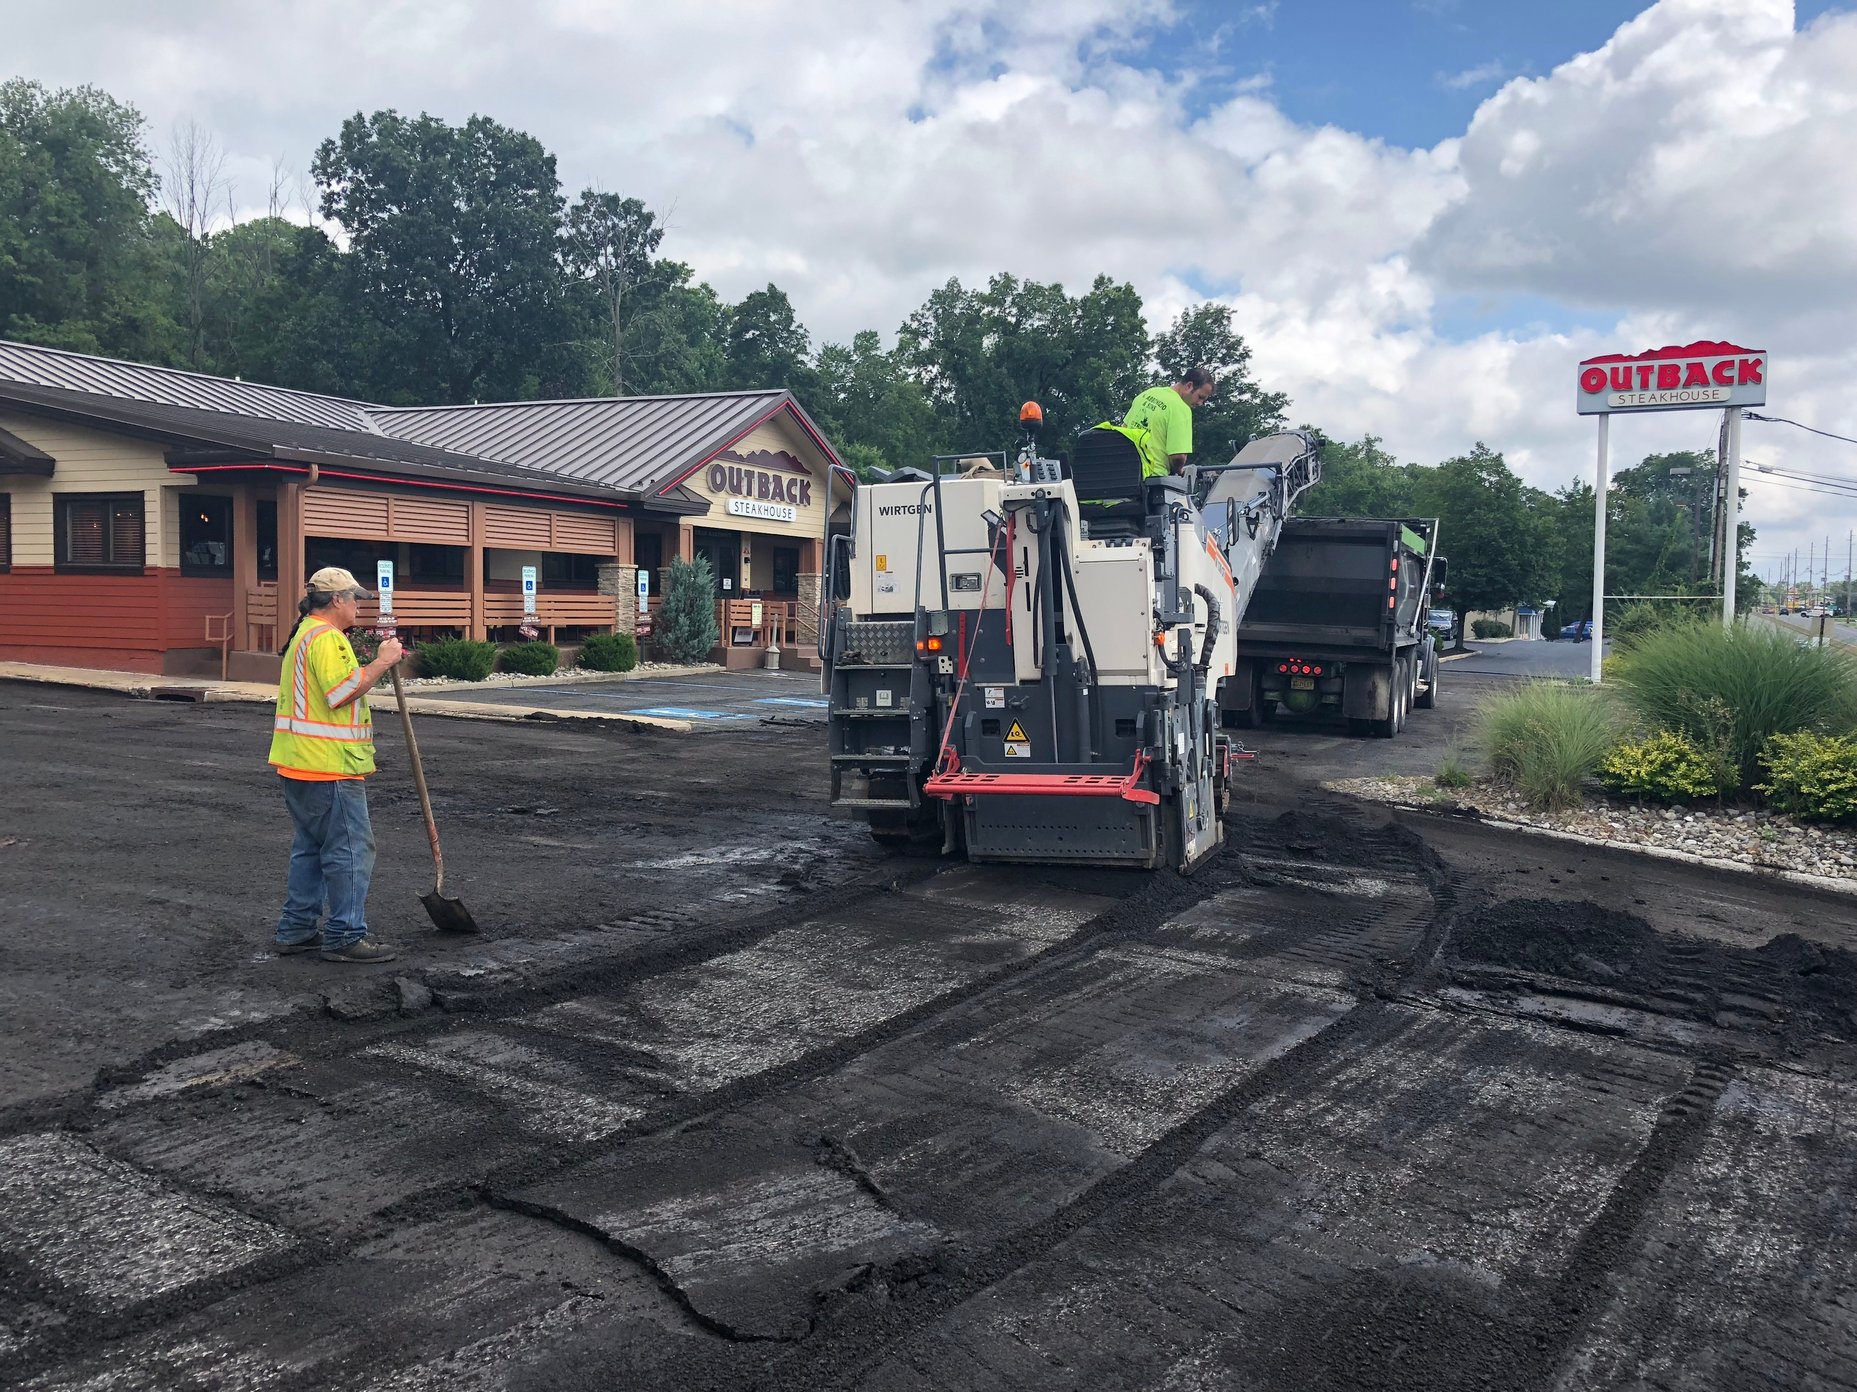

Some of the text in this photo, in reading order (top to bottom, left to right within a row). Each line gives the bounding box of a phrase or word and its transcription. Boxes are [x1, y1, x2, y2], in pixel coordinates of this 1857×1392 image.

[1580, 358, 1763, 394] OUTBACK
[1618, 389, 1720, 405] STEAKHOUSE
[707, 463, 811, 506] OUTBACK
[734, 501, 792, 519] STEAKHOUSE
[879, 504, 932, 516] WIRTGEN
